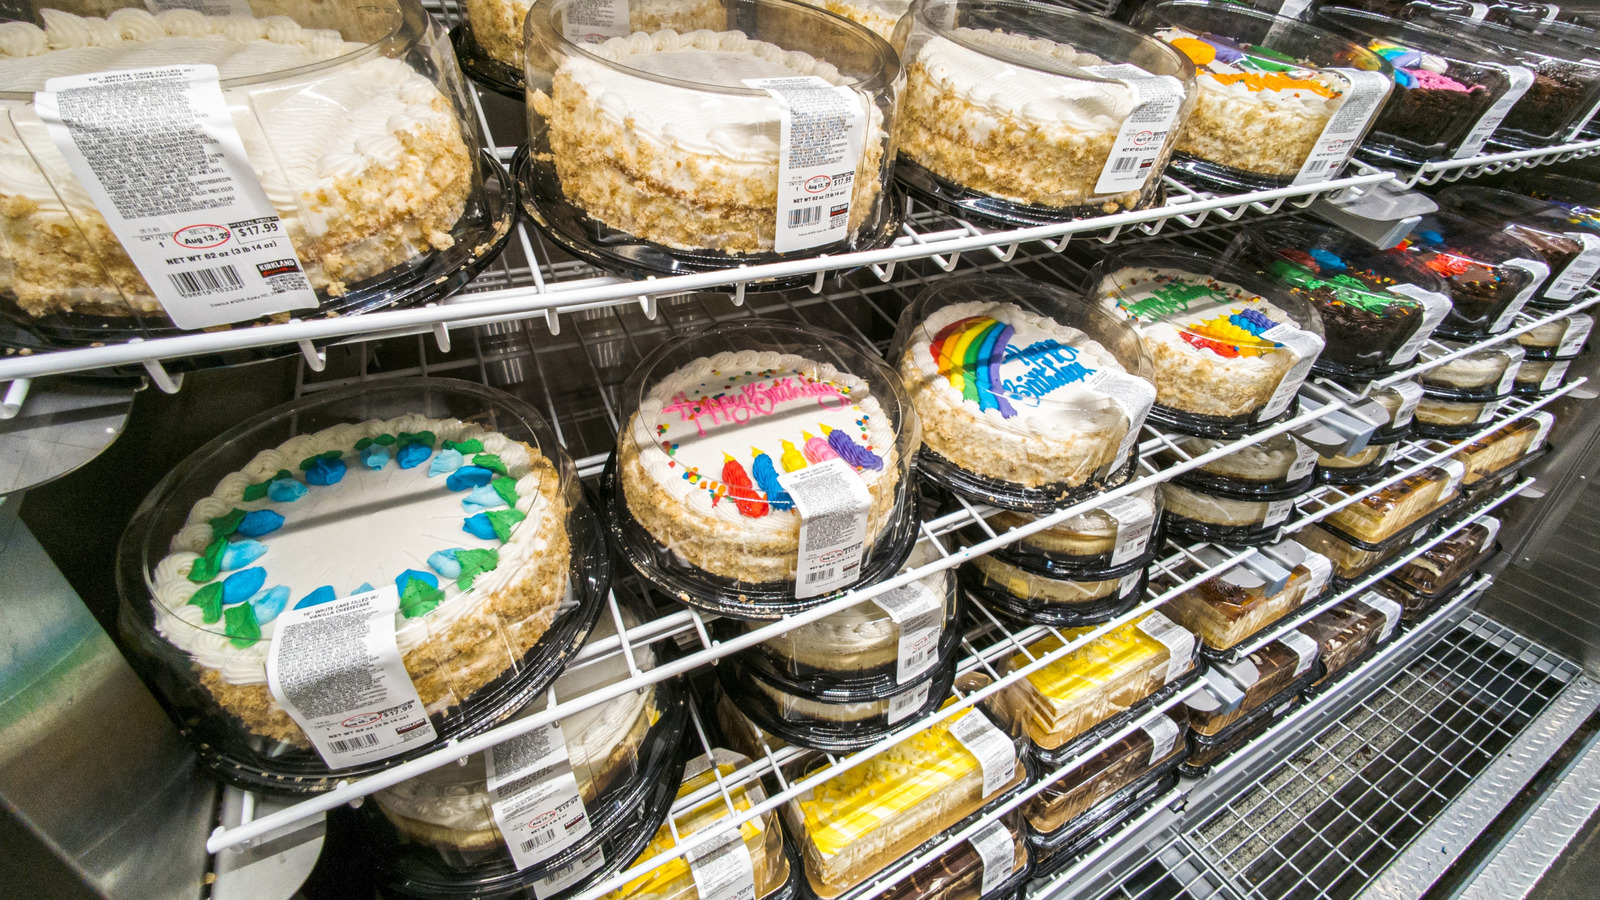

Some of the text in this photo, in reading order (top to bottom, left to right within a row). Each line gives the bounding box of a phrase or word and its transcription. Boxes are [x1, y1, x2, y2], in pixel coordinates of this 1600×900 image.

[136, 72, 183, 80] CHEESECAKE
[833, 176, 852, 187] $17.99
[238, 222, 279, 237] $17.99
[185, 236, 203, 245] Aug
[203, 233, 218, 242] 13,
[166, 257, 186, 266] NET
[187, 255, 203, 263] WT
[205, 252, 217, 260] 62
[231, 248, 242, 256] (3
[264, 241, 278, 249] oz)
[259, 259, 295, 272] KIRKLAND
[663, 374, 852, 437] Happy Birthday
[309, 601, 370, 619] VANILLA CHEESECAKE
[315, 606, 333, 614] WHITE
[383, 704, 413, 719] $17.99
